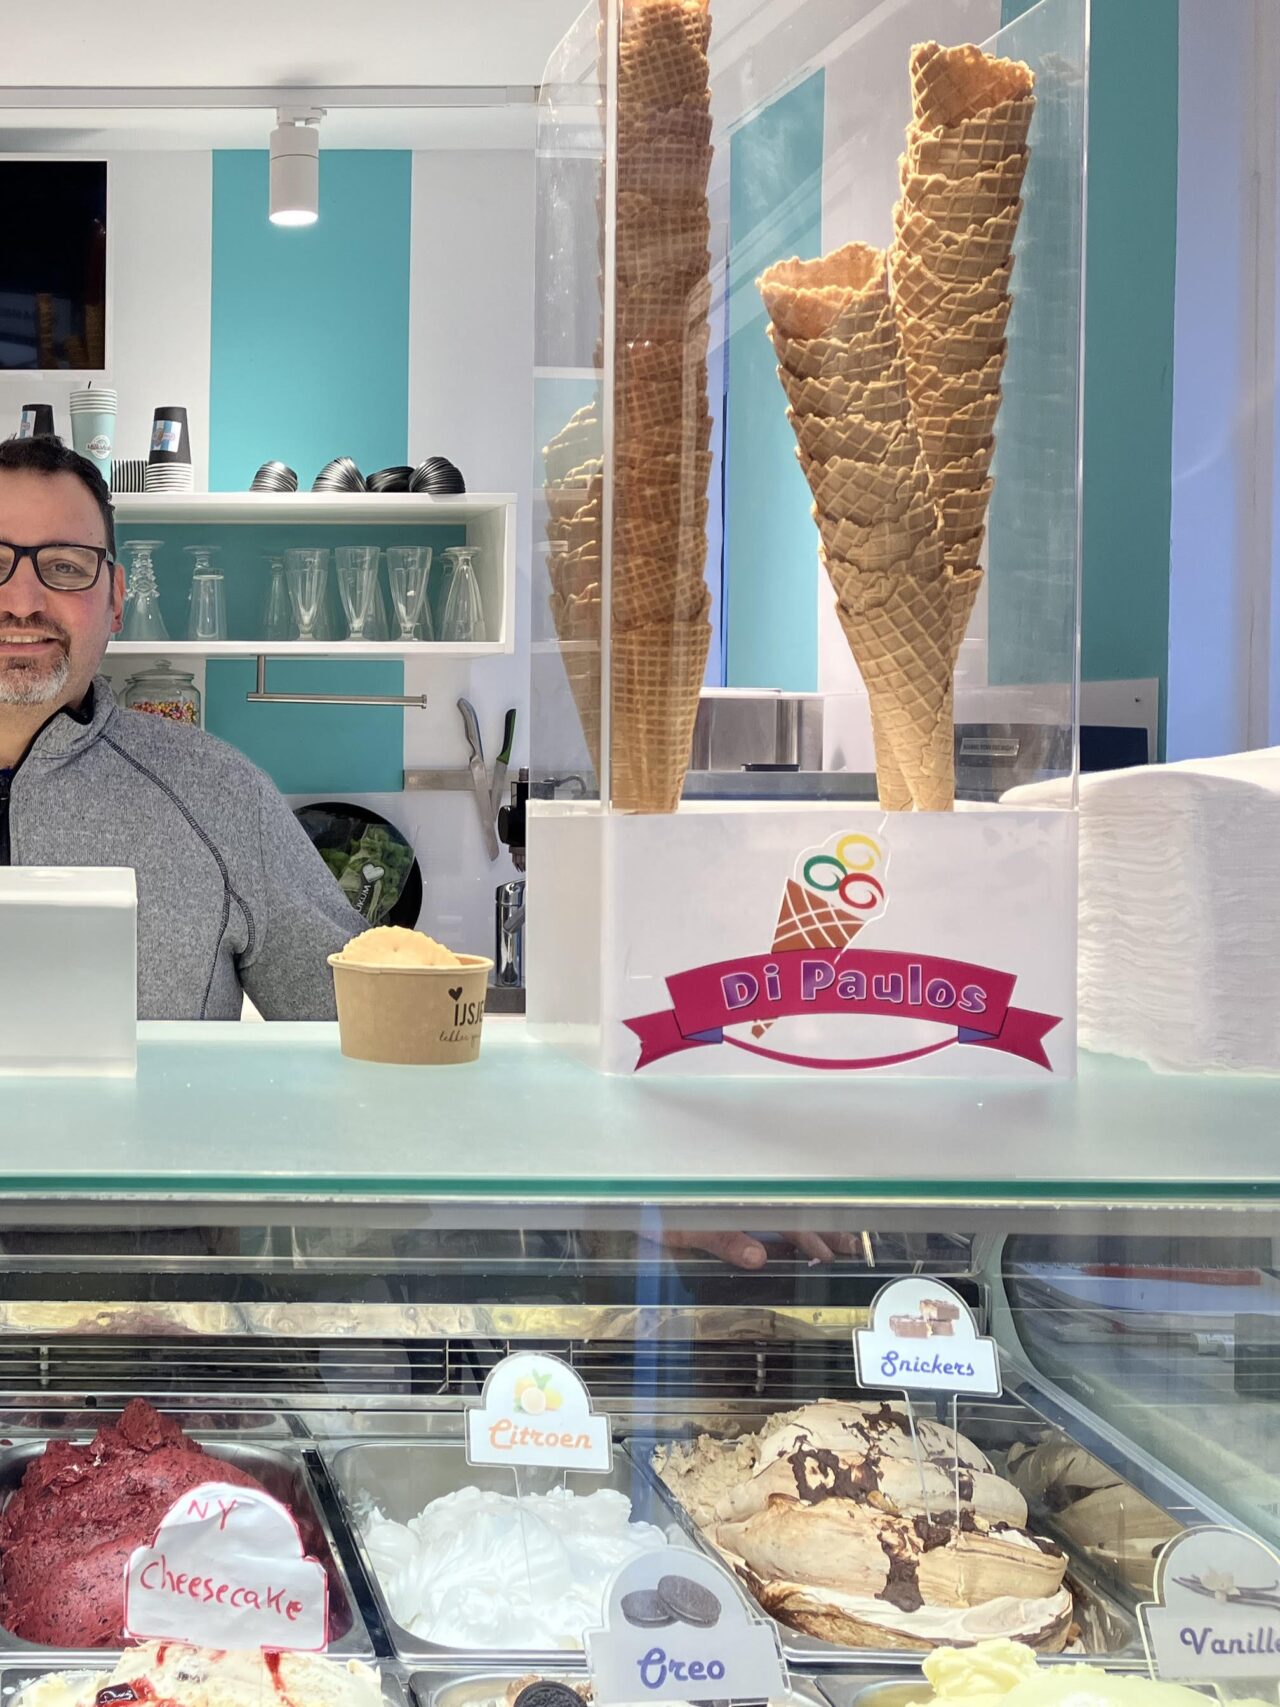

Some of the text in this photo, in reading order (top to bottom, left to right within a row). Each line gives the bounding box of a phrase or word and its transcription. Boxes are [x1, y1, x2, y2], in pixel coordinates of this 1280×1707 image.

[720, 959, 989, 1014] Di Paulos
[880, 1350, 975, 1377] Snickers
[490, 1419, 592, 1450] Citroen
[187, 1499, 237, 1531] NY
[140, 1554, 303, 1621] Cheesecake
[637, 1647, 725, 1690] Oreo
